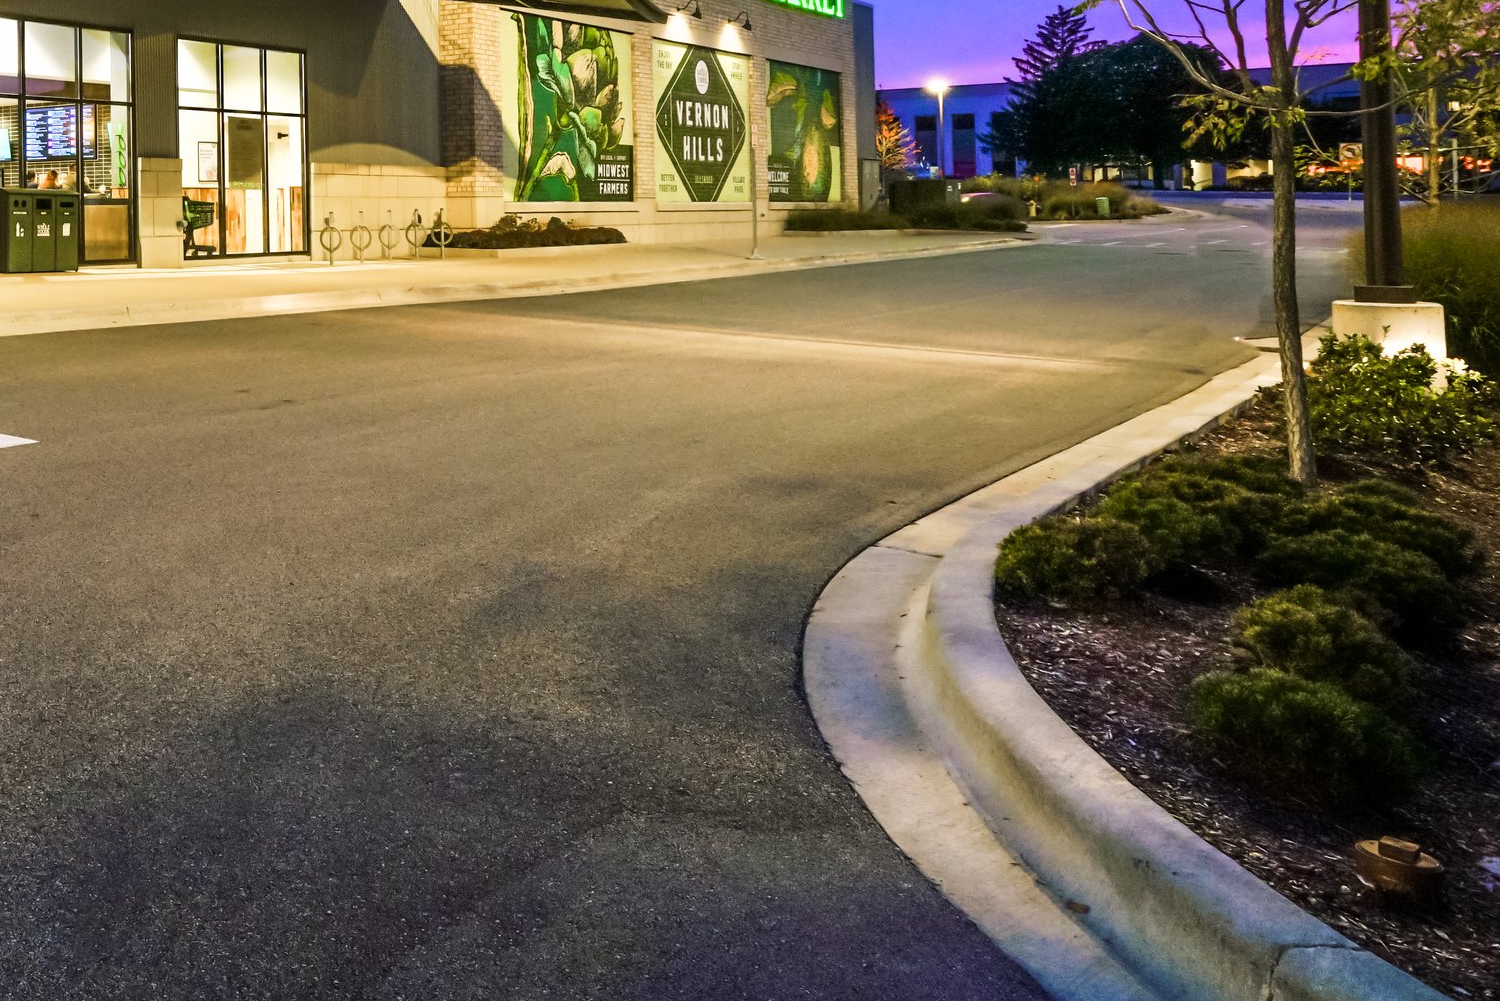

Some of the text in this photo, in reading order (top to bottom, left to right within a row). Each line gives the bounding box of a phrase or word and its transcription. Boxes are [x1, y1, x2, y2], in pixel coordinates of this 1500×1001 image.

[676, 100, 729, 129] VERNON
[683, 135, 723, 162] HILLS
[597, 164, 629, 178] MIDWEST
[599, 182, 628, 195] FARMERS
